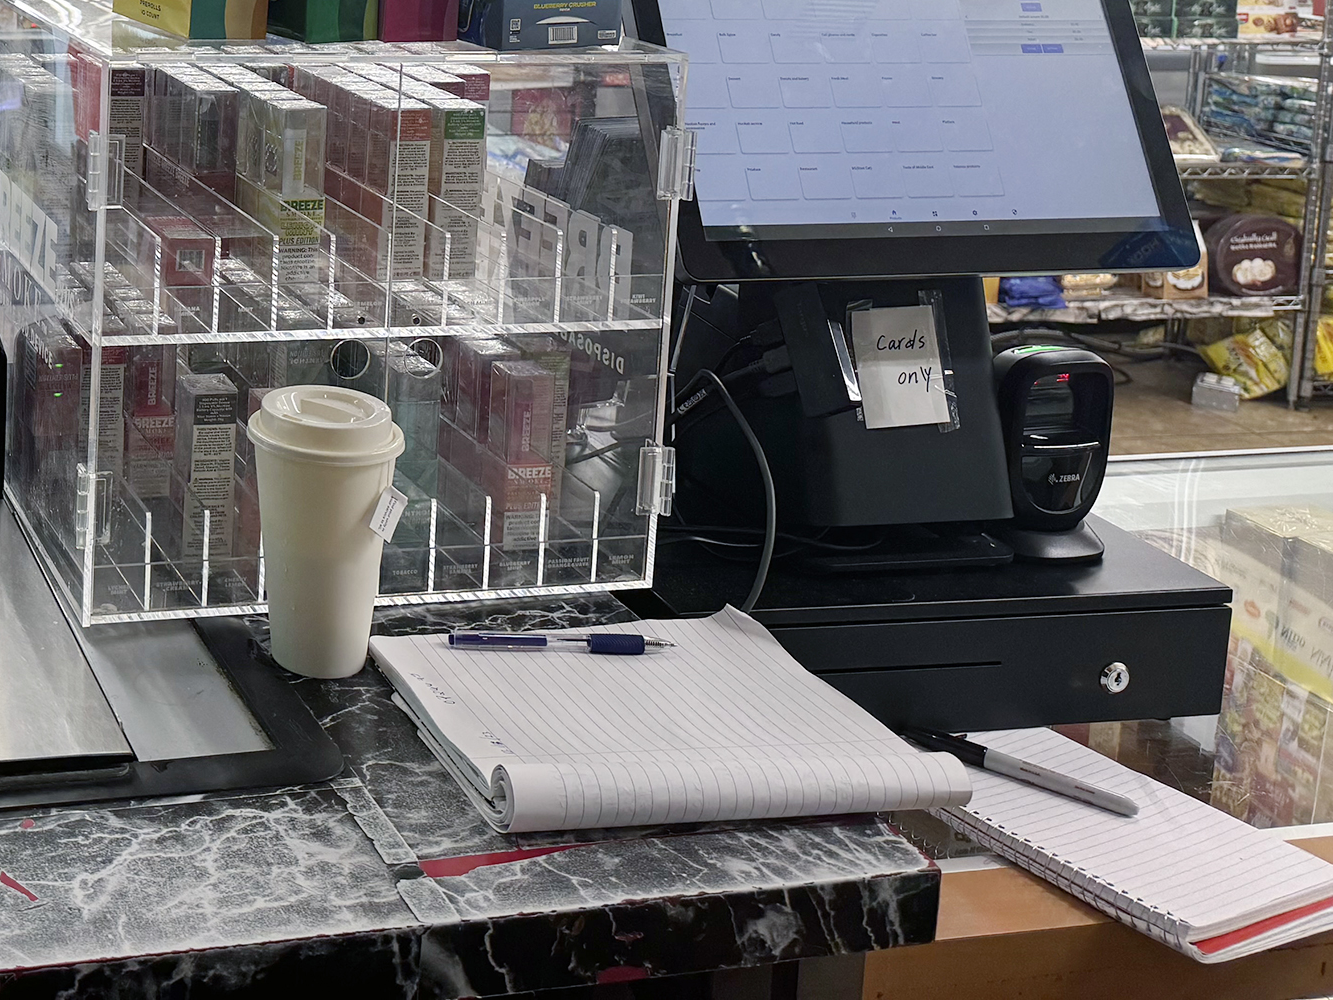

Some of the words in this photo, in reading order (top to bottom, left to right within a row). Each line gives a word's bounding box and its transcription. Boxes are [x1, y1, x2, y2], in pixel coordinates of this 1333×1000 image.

[293, 141, 303, 181] BREEZE
[280, 199, 324, 212] BREEZE
[279, 237, 296, 245] PLUS
[297, 236, 319, 244] EDITION
[876, 329, 926, 351] Cards
[147, 367, 157, 406] BREEZE
[897, 366, 932, 392] only
[135, 416, 174, 429] BREEZE
[522, 410, 532, 453] BREEZE
[508, 467, 552, 480] BREEZE
[1058, 473, 1081, 483] ZEBRA
